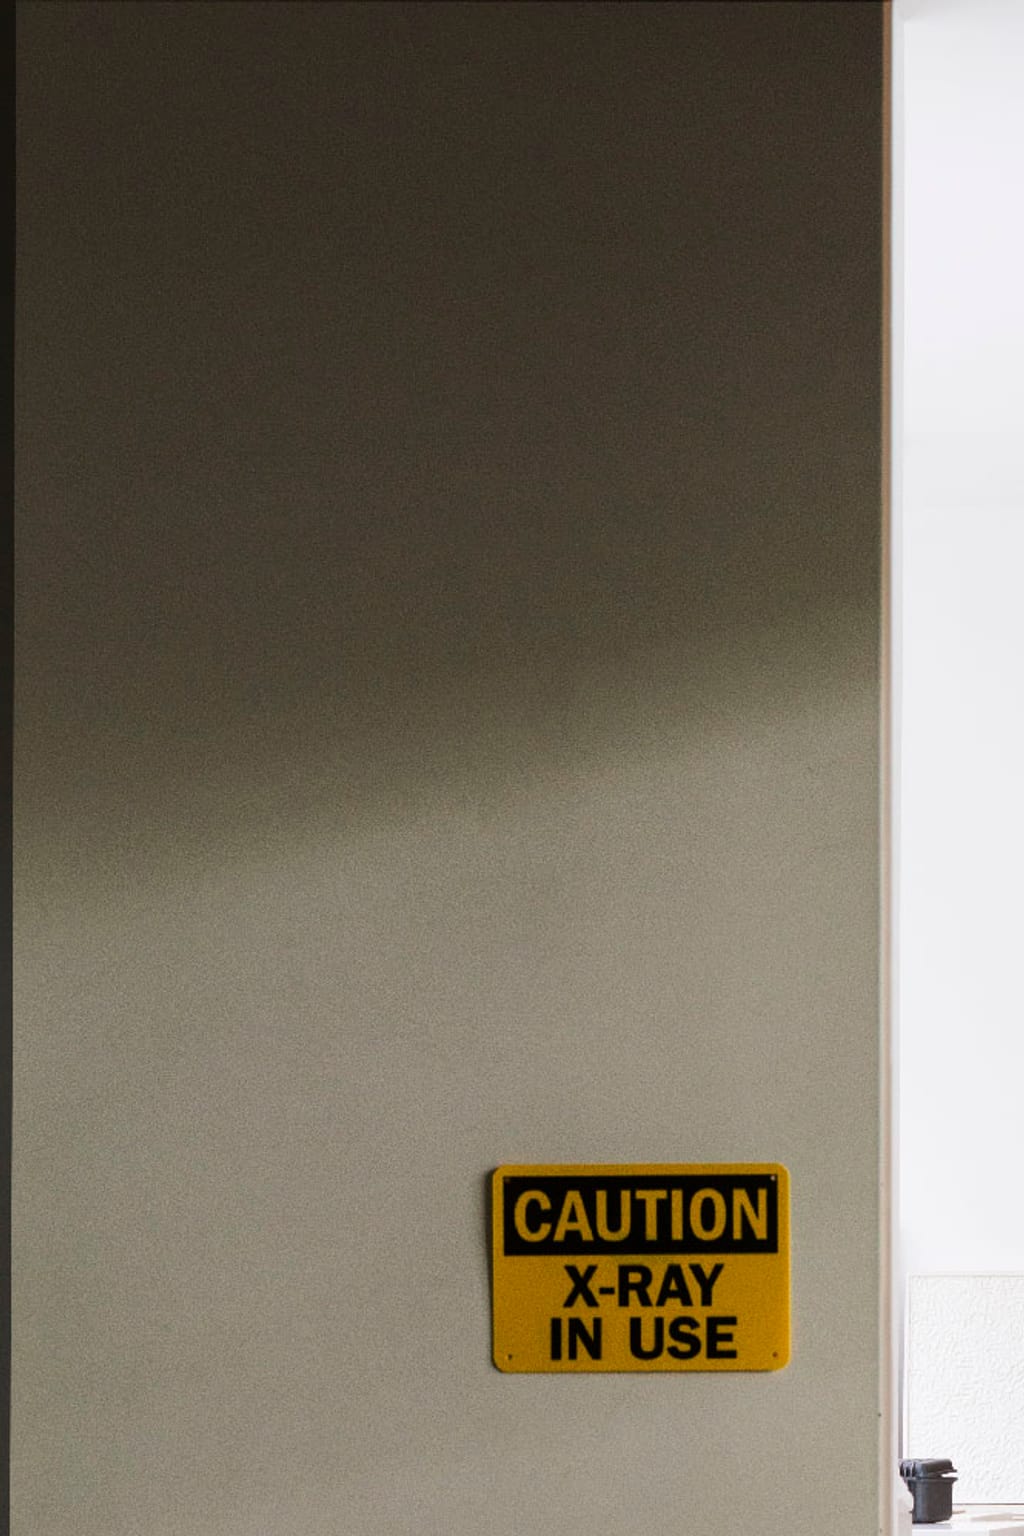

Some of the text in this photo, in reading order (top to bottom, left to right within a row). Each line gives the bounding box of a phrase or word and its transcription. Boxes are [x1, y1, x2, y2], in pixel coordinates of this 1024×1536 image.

[514, 1188, 768, 1242] CAUTION
[563, 1263, 725, 1308] X-RAY
[551, 1316, 738, 1361] IN USE
